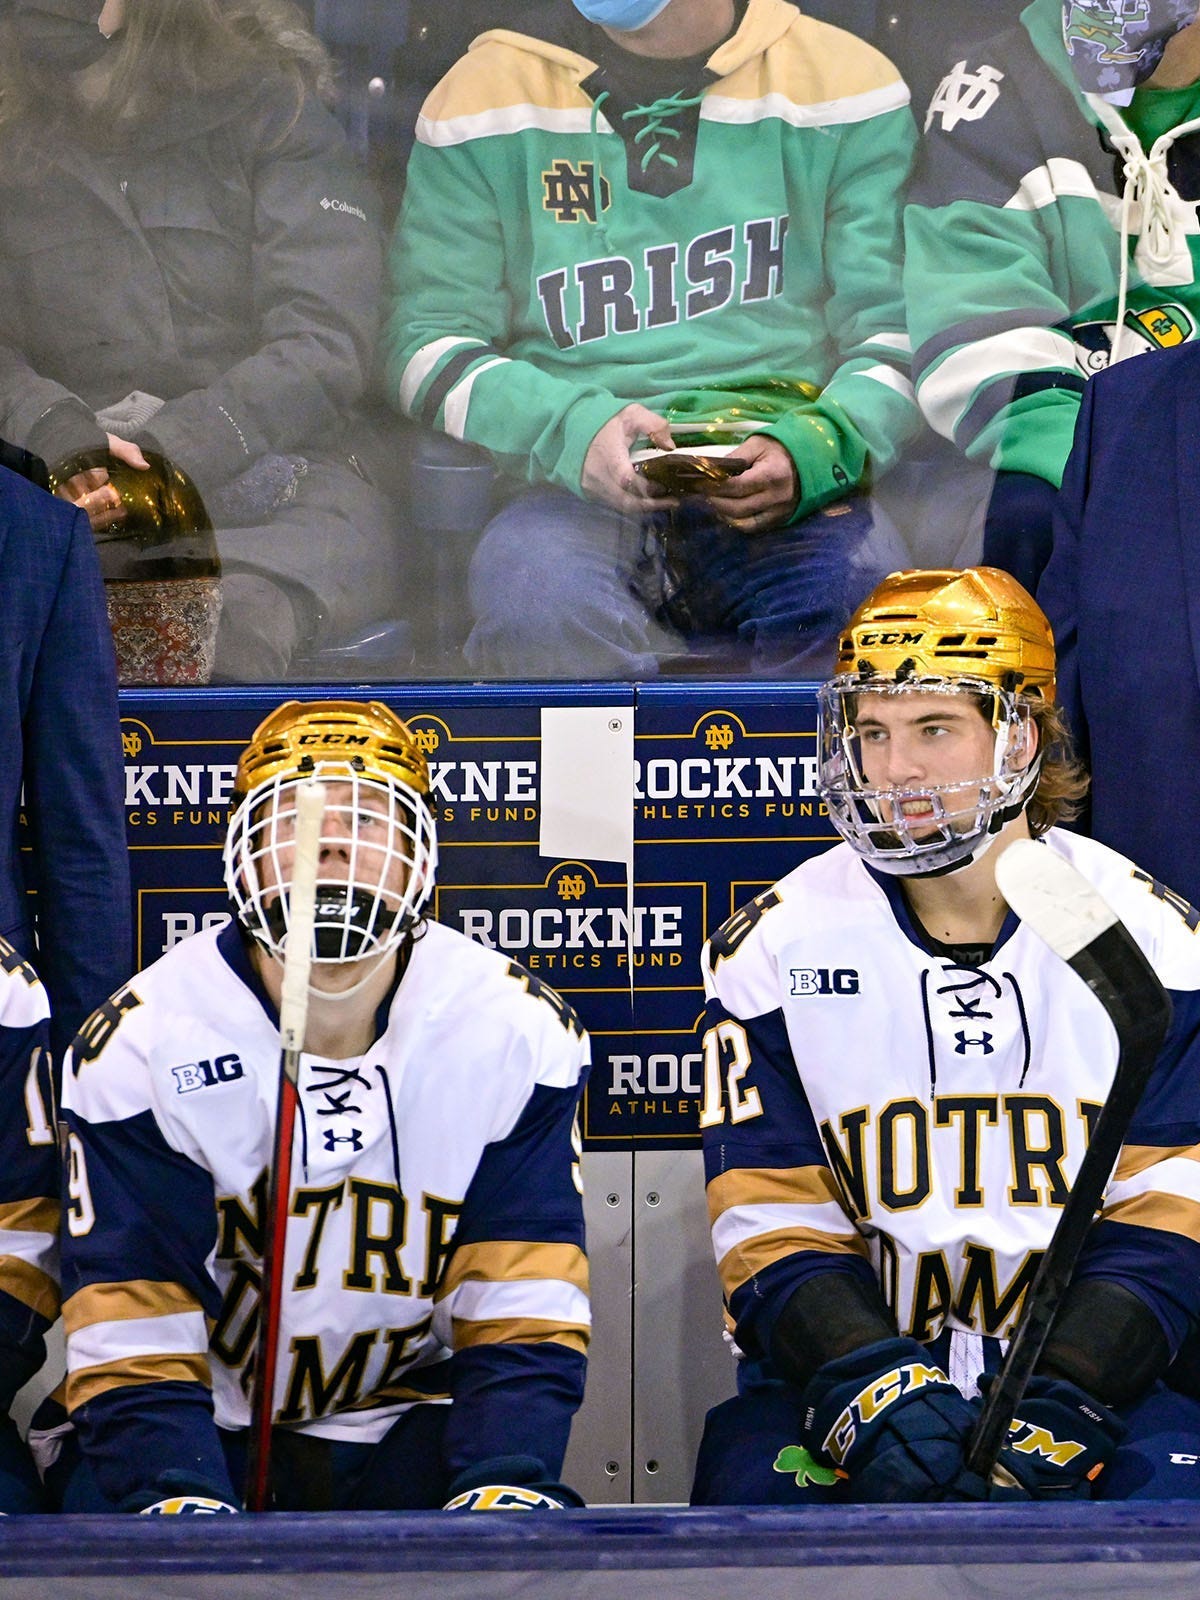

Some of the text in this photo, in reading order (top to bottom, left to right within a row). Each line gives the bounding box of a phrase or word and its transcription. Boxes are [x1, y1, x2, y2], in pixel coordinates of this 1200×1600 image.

[537, 215, 789, 350] IRISH
[861, 633, 924, 646] CCM
[298, 734, 370, 746] CCM
[124, 764, 237, 805] KNE
[428, 761, 537, 802] KNE
[634, 757, 818, 799] OCKNE
[471, 807, 536, 821] FUND
[634, 803, 830, 819] HLETICS FUND
[459, 906, 682, 949] ROCKNE
[529, 953, 682, 968] ETICS FUND
[608, 1054, 703, 1095] ROC
[699, 1019, 764, 1129] 12
[215, 1166, 466, 1299] NTRE
[804, 1406, 815, 1431] IRISH
[822, 1362, 951, 1466] CCM
[1078, 1404, 1103, 1423] IRISH
